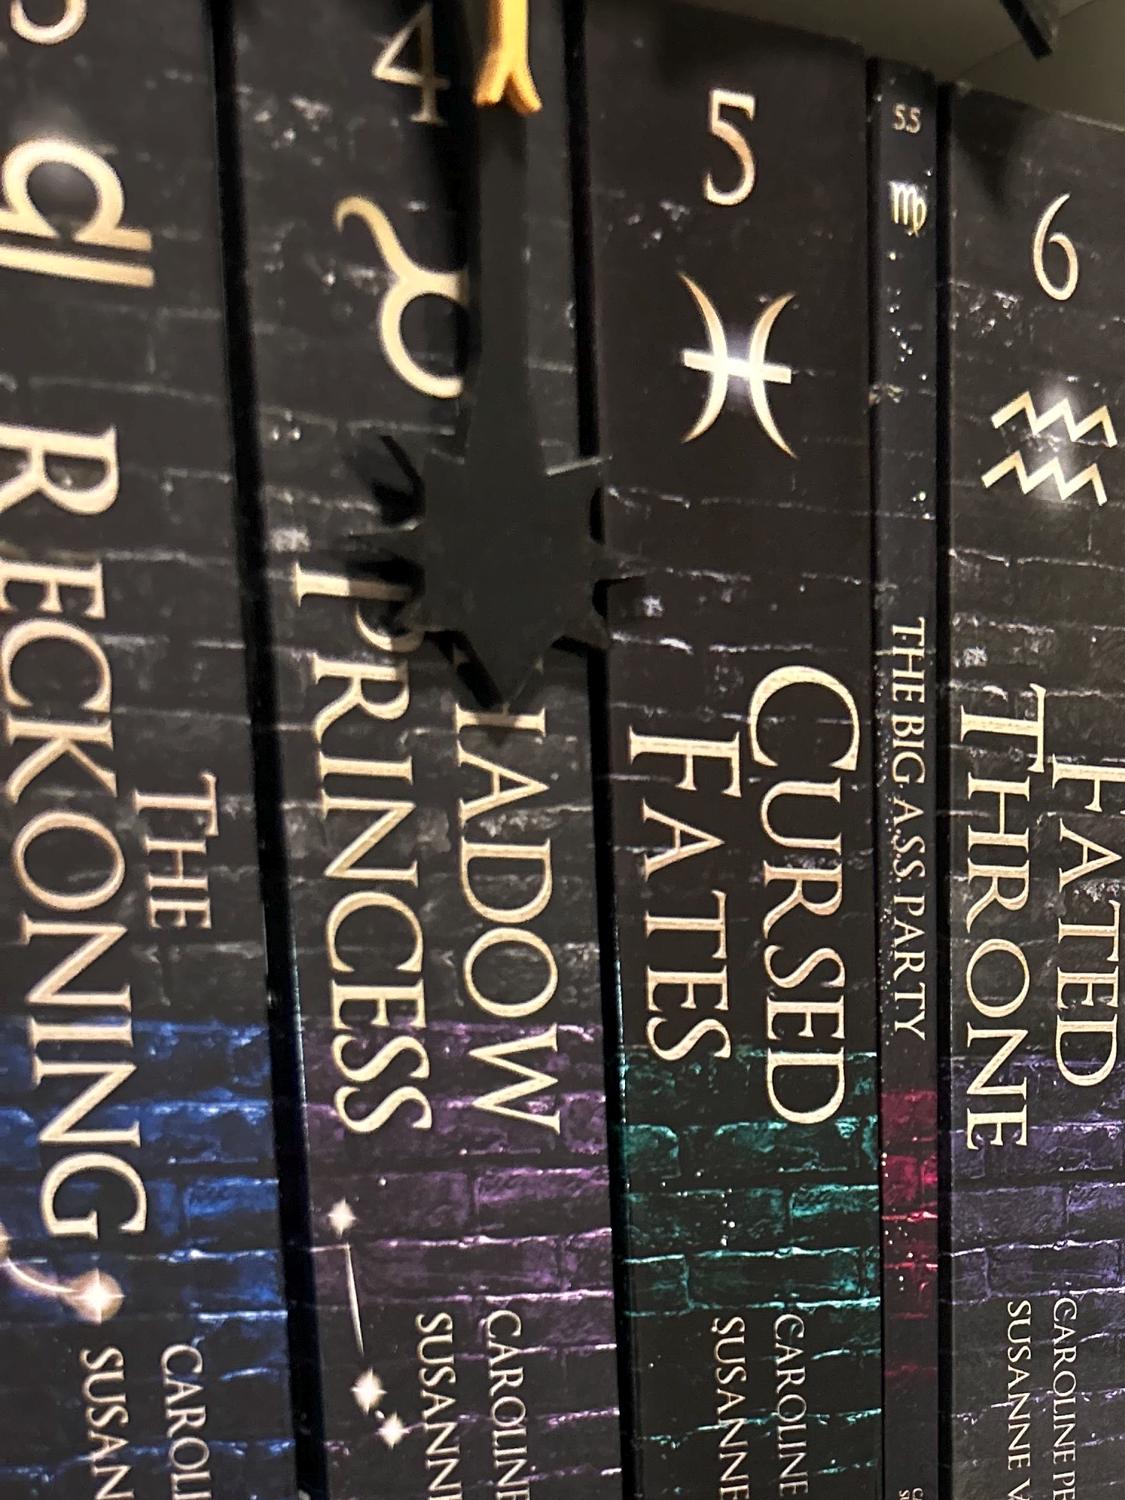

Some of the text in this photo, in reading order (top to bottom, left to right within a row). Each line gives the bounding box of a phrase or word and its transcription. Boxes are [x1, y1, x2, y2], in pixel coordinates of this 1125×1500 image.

[372, 4, 450, 126] 4
[704, 88, 756, 206] 5
[1033, 193, 1079, 301] 6
[891, 617, 926, 706] THE
[0, 425, 148, 1240] RECKONING
[892, 712, 926, 786] BIG
[134, 772, 219, 930] THE
[293, 560, 433, 1133] PRINCESS
[628, 725, 741, 1062] FATES
[749, 666, 859, 1124] CURSED
[959, 684, 1045, 1150] THRONE
[892, 894, 926, 1040] PARTY
[774, 1314, 809, 1497] CAROLINE
[1006, 1300, 1033, 1472] SUSANNE
[1052, 1297, 1078, 1464] CAROLINE
